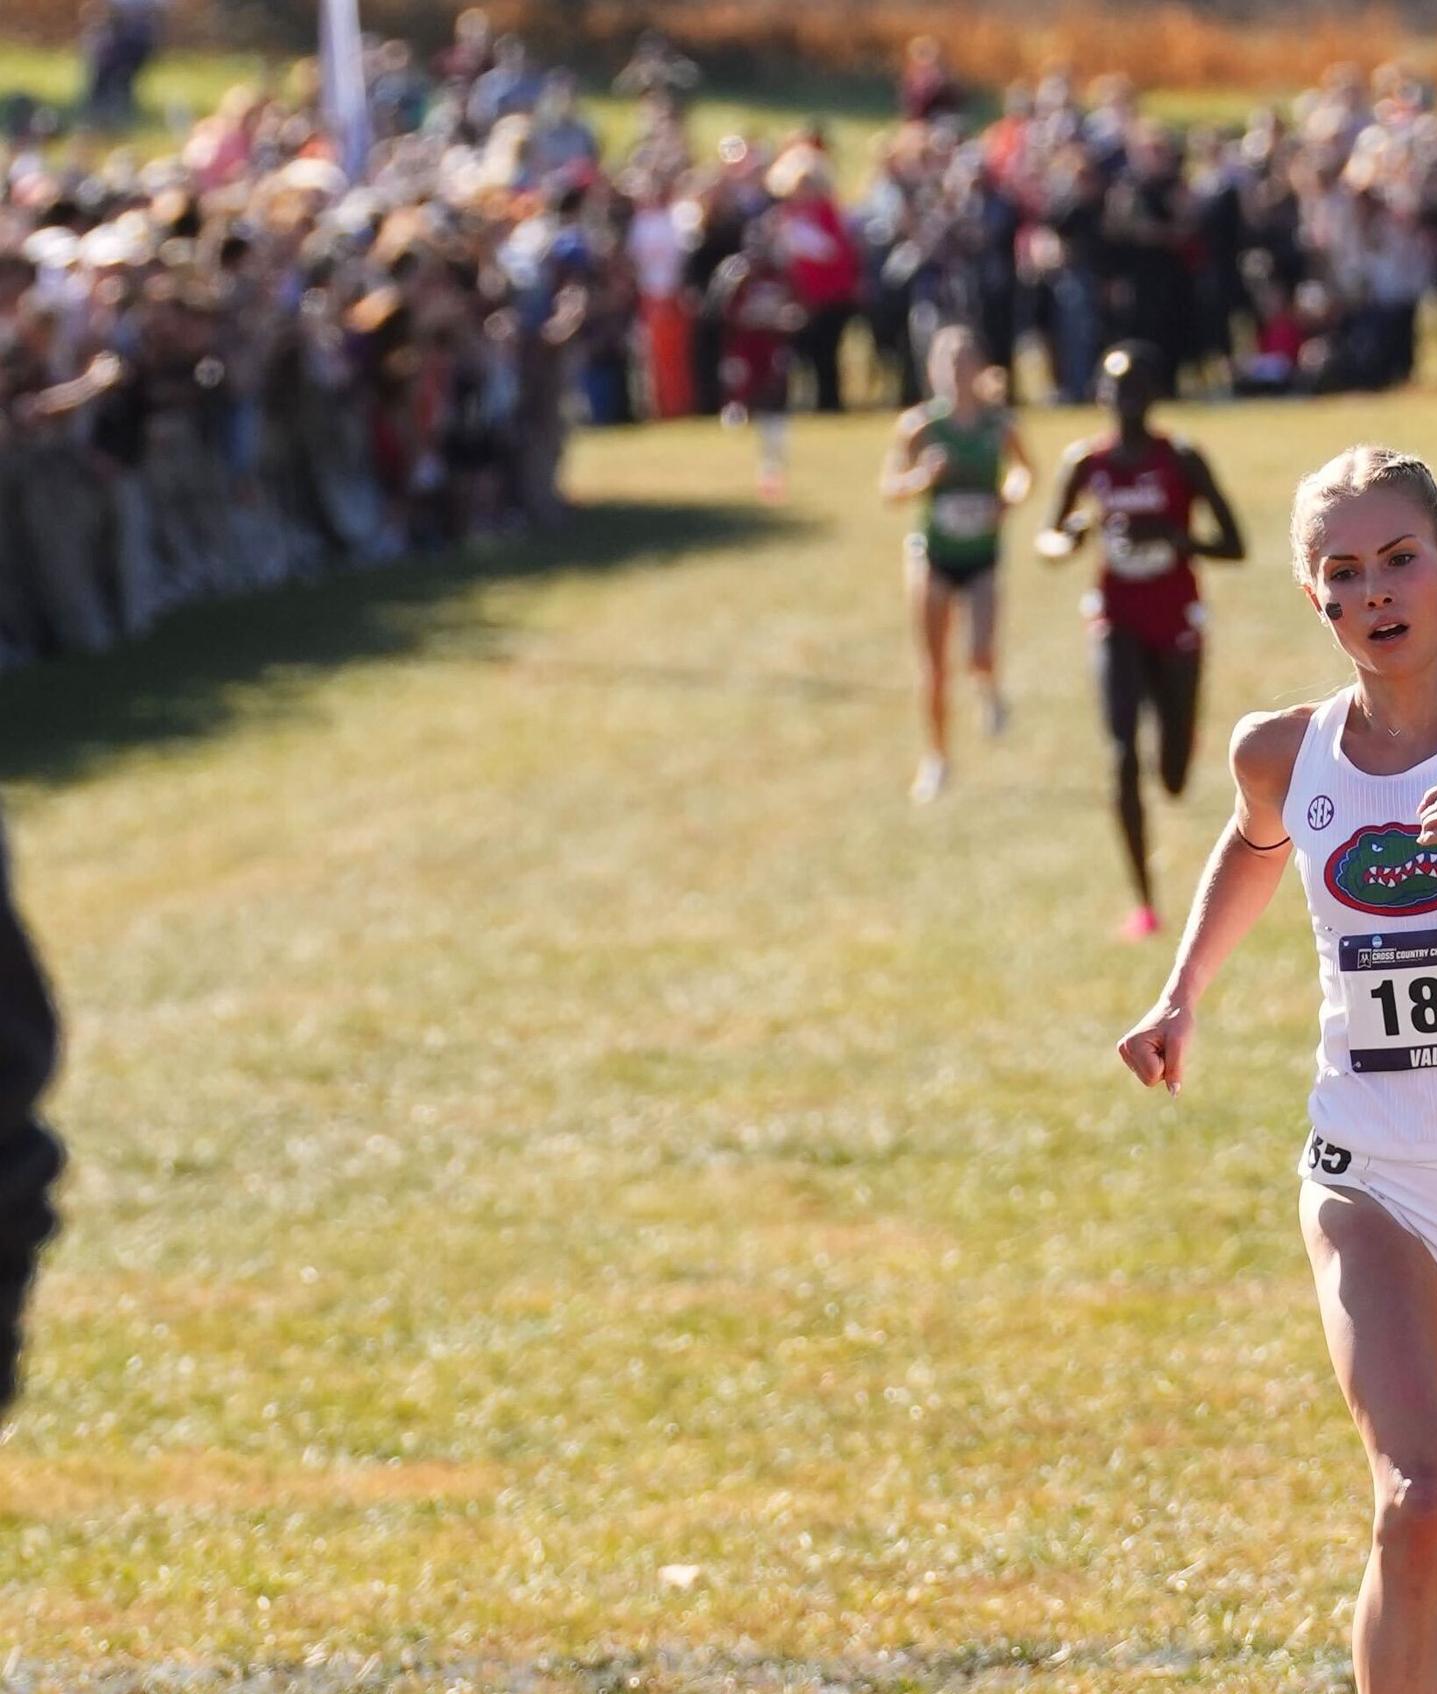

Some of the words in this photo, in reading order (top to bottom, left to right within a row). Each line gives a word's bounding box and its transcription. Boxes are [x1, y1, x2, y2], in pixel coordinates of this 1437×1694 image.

[1308, 796, 1334, 830] SEC
[1372, 951, 1394, 960] CROSS
[1396, 949, 1428, 959] COUNTRY
